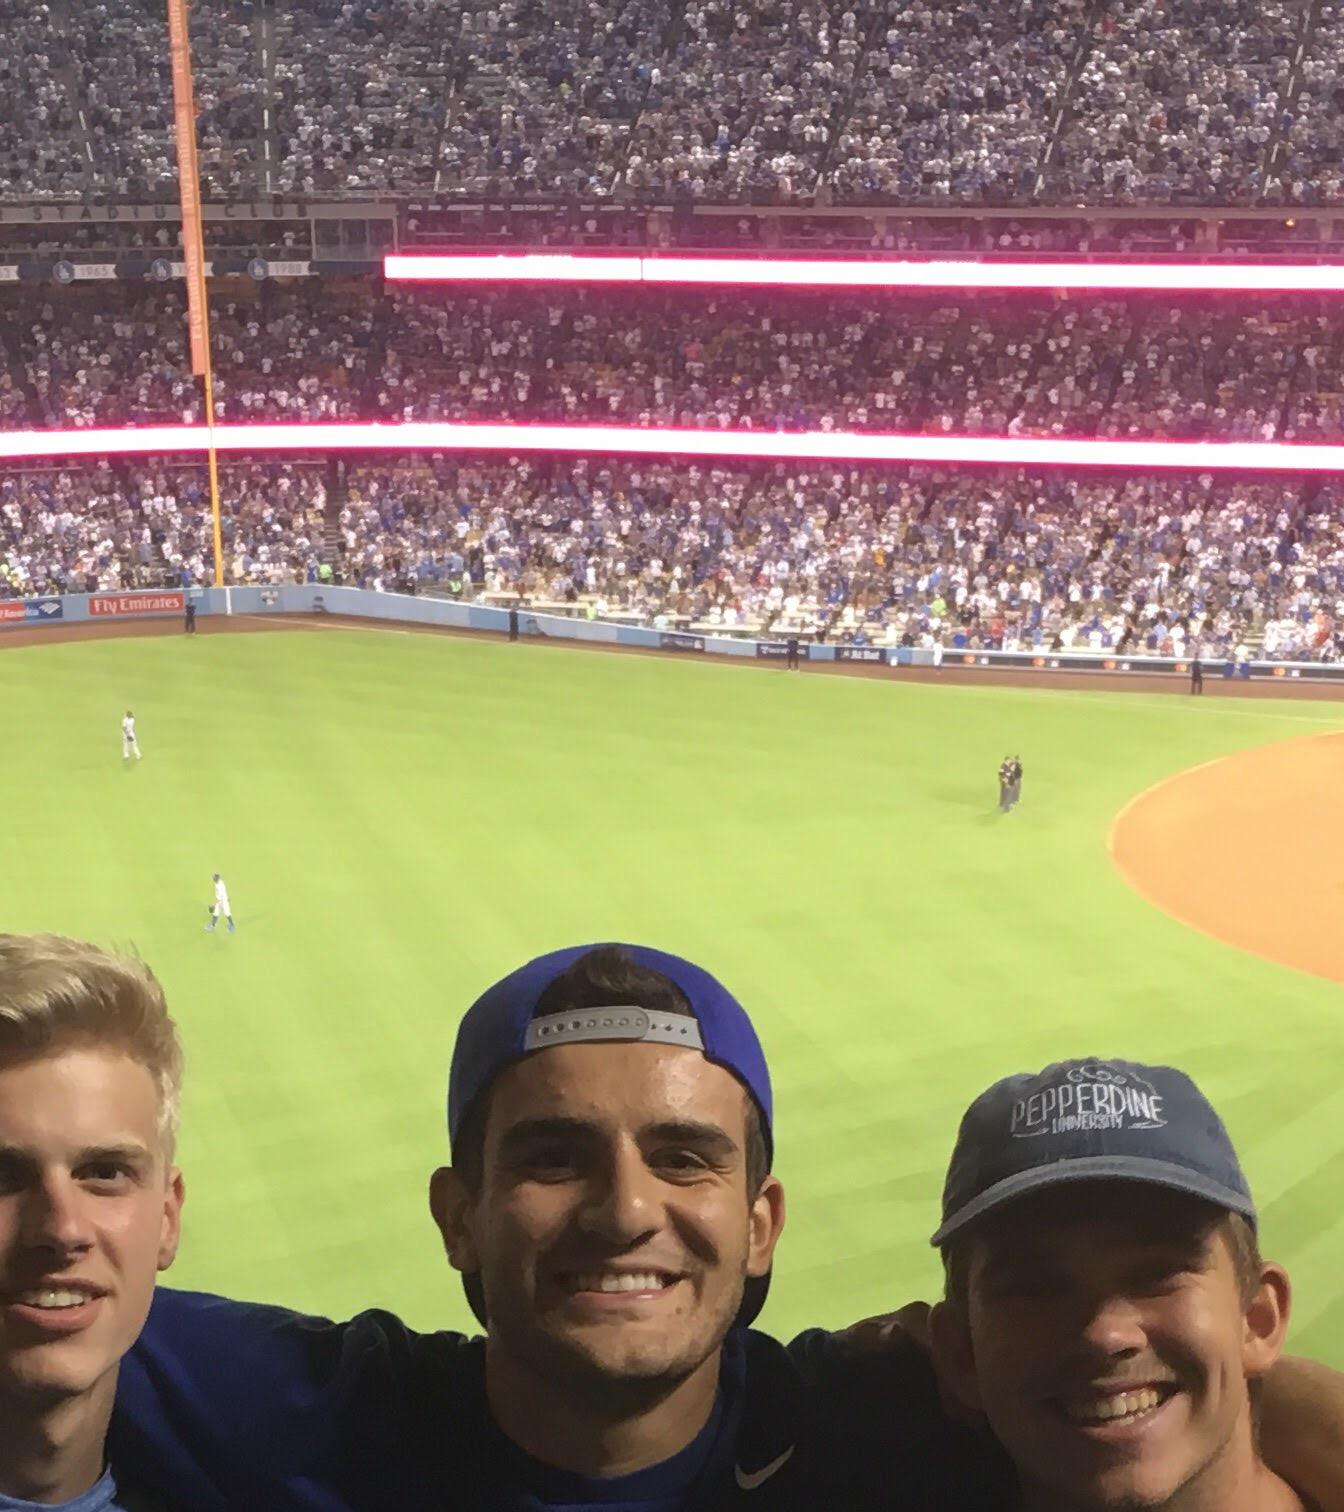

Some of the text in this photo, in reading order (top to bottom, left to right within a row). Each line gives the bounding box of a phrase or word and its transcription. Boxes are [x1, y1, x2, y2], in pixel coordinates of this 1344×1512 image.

[33, 204, 167, 221] STADIU
[224, 202, 308, 218] CLUB
[94, 597, 180, 615] Fly Emirates
[1011, 1083, 1164, 1132] PEPPERDINE
[1052, 1113, 1124, 1134] UNIVERSITY
